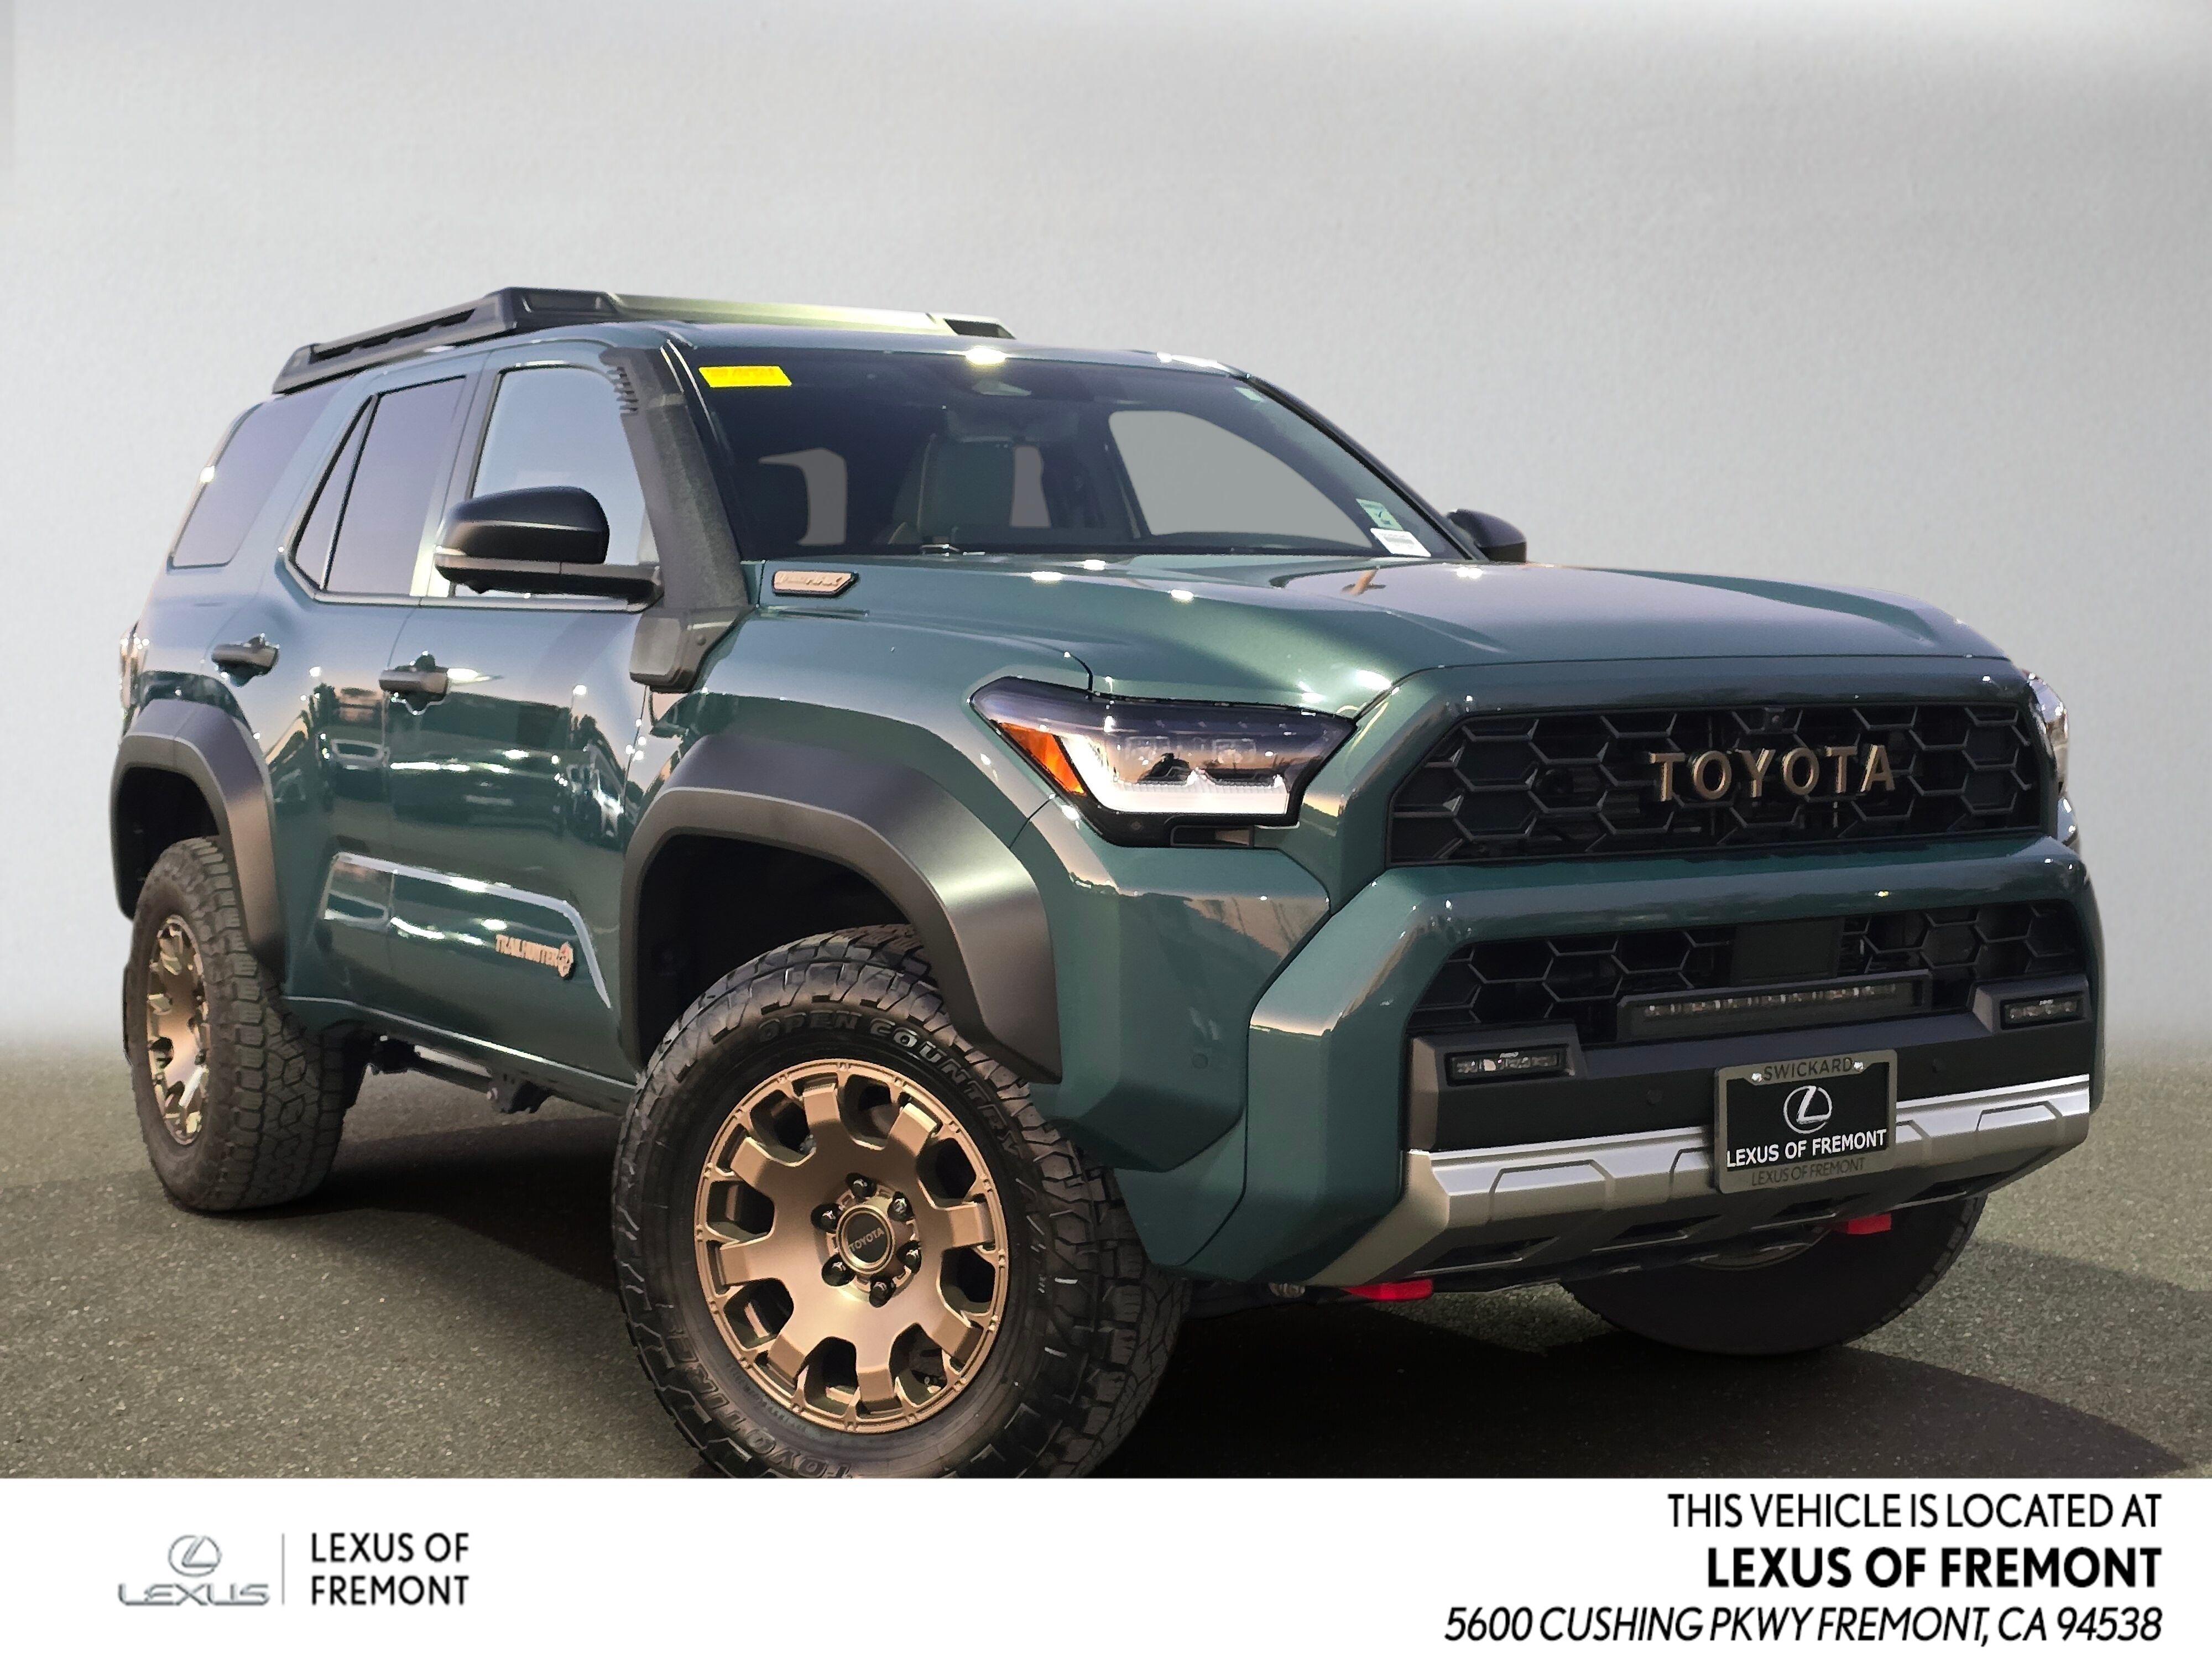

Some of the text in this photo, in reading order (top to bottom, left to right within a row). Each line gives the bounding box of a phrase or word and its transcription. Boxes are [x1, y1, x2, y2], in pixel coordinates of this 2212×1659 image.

[1649, 743, 1895, 802] TOYOTA
[758, 1010, 1025, 1159] OPEN COUNTRY
[1763, 1057, 1853, 1081] SWICKARD
[1726, 1129, 1887, 1167] LEXUS OF FREMONT
[1751, 1157, 1866, 1187] LEXUS OF FREMONT
[848, 1227, 885, 1251] TOYOTA
